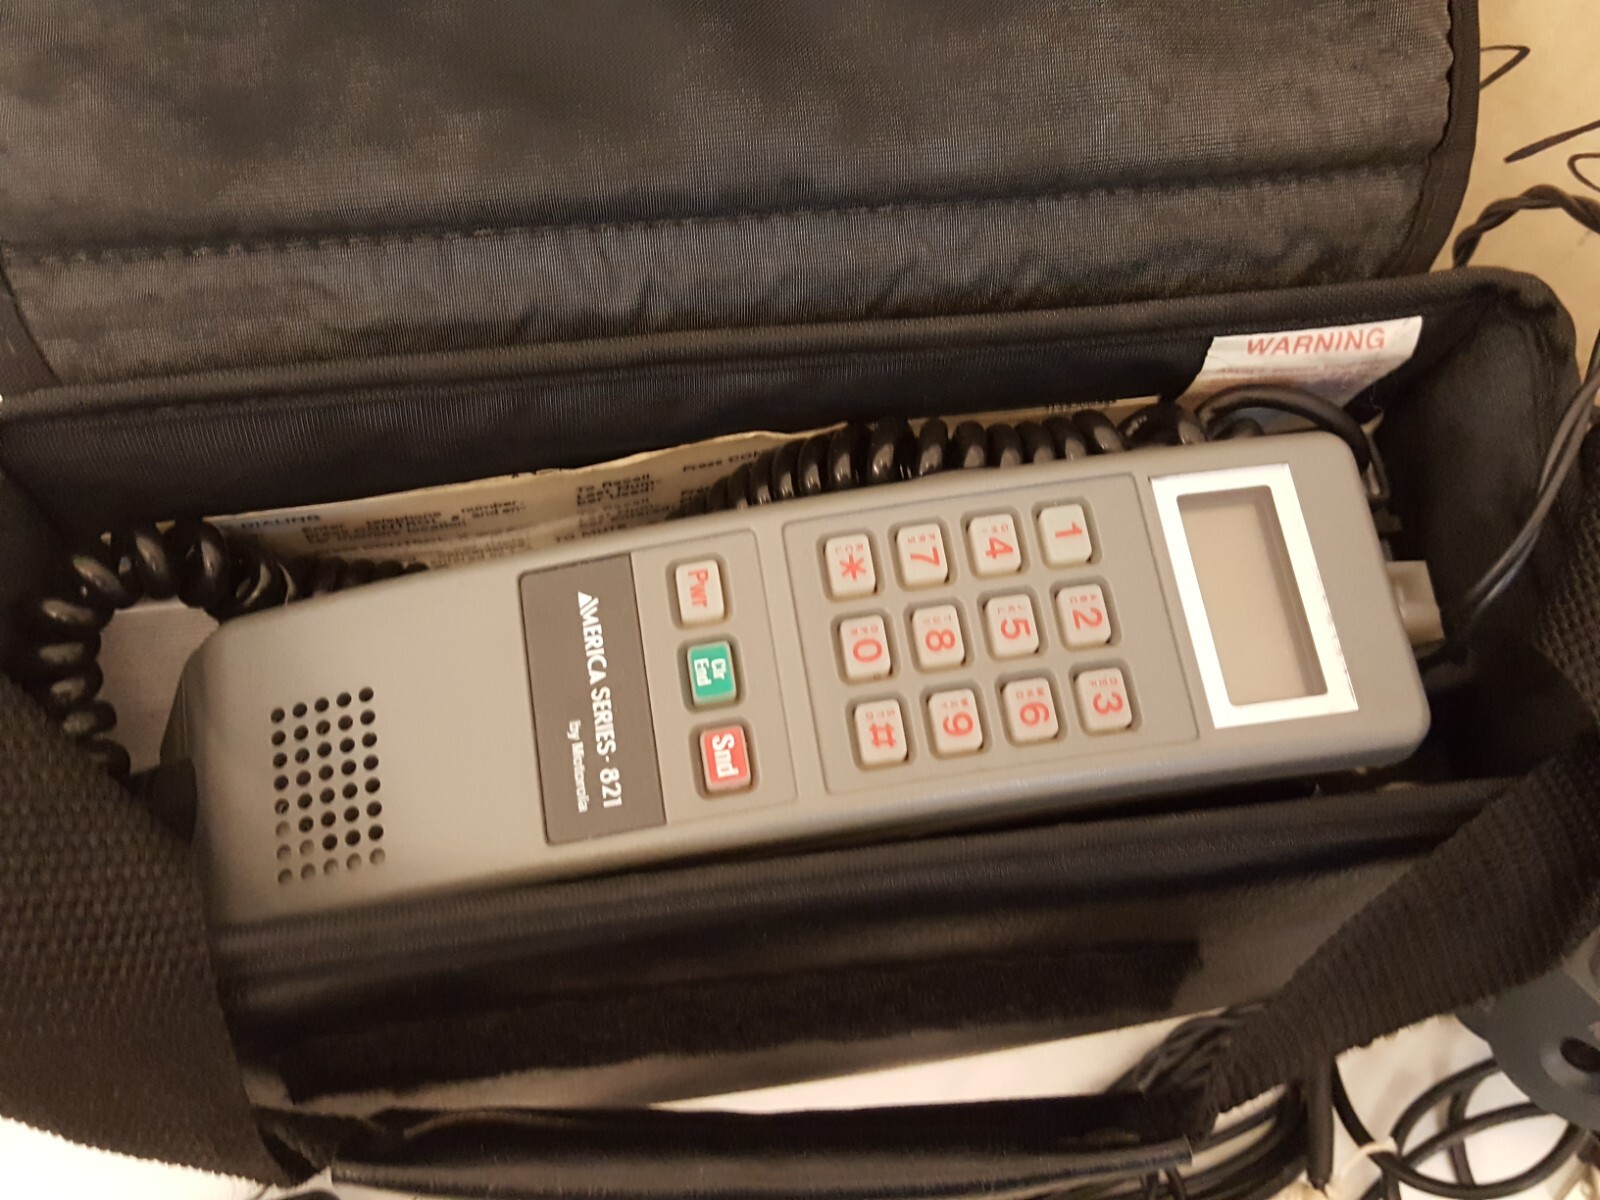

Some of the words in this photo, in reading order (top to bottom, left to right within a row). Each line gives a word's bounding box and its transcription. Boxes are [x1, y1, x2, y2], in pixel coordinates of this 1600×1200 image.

[1247, 327, 1385, 355] WARNING
[1055, 522, 1082, 538] 1
[910, 546, 940, 566] 7
[986, 537, 1013, 559] 4
[688, 569, 709, 608] Pwr
[1001, 618, 1031, 640] 5
[1072, 607, 1103, 630] 2
[853, 639, 882, 662] 0
[925, 629, 956, 652] 8
[694, 658, 712, 686] End
[711, 658, 726, 680] Clr
[578, 591, 607, 685] AMERICA
[599, 767, 623, 808] 821
[1092, 691, 1123, 715] 3
[943, 712, 974, 737] 9
[1020, 702, 1050, 726] 6
[567, 720, 582, 740] by
[711, 734, 738, 778] Snd
[572, 742, 590, 813] Motorola
